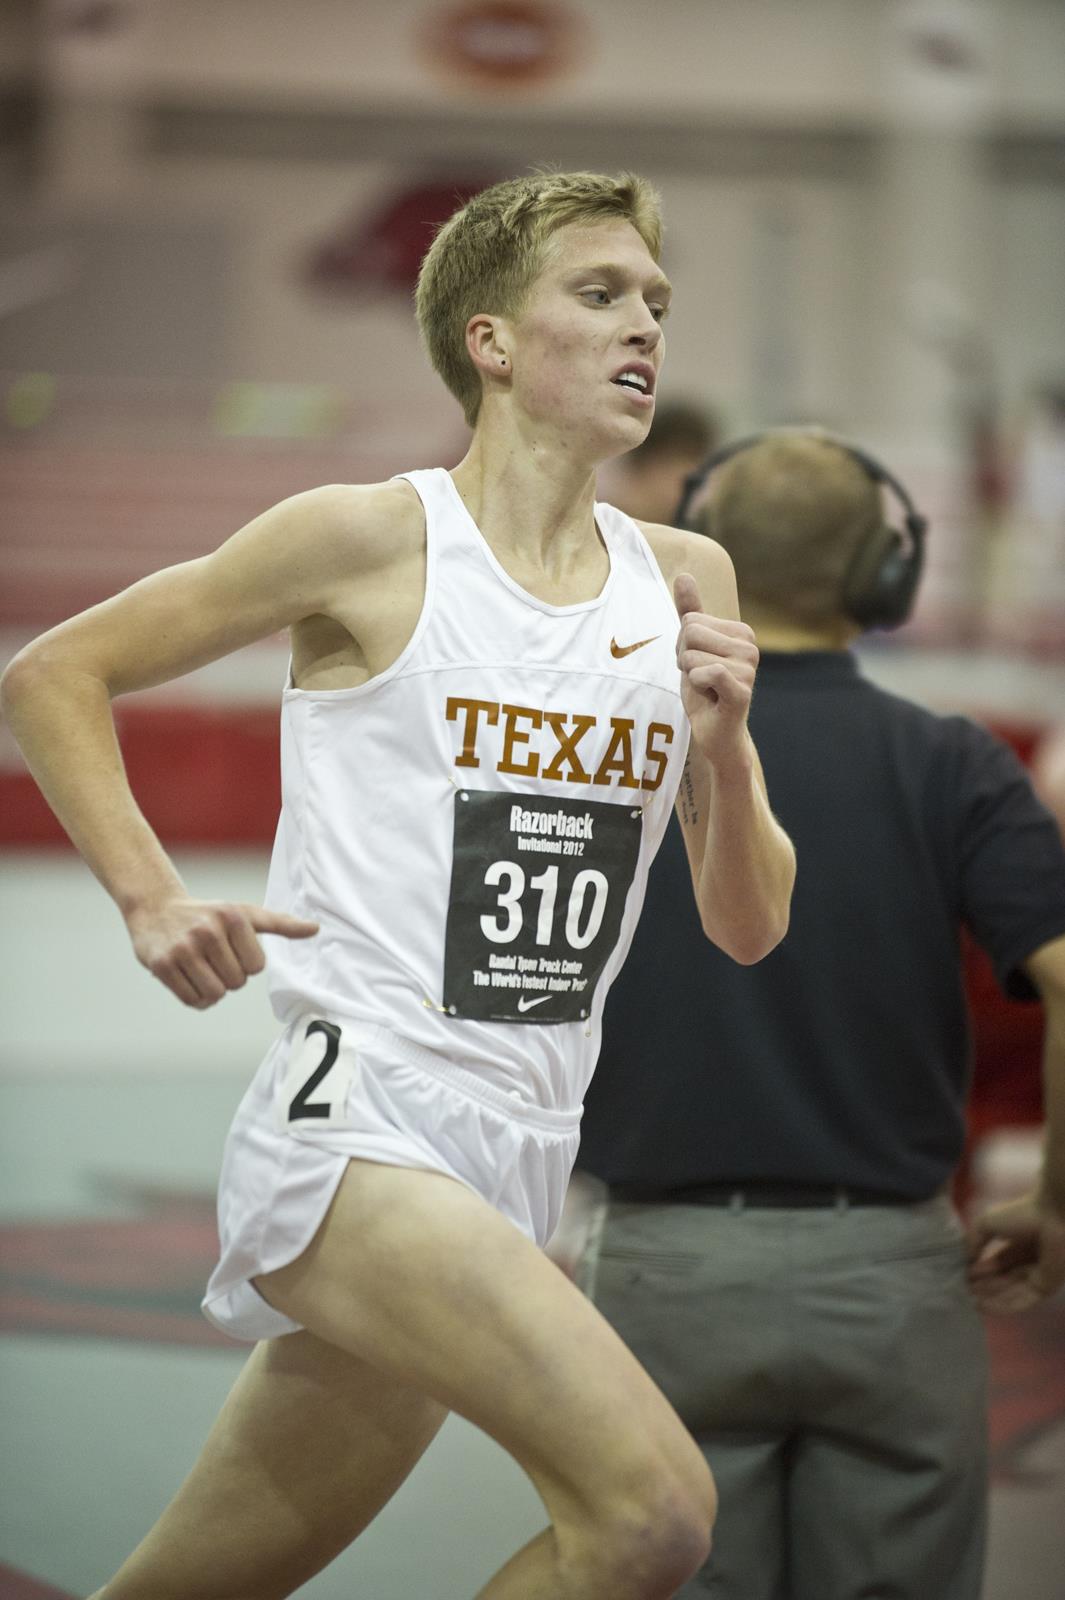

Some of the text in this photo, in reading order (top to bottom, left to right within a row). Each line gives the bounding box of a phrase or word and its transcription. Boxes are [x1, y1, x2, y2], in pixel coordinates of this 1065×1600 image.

[446, 697, 674, 792] TEXAS
[510, 805, 594, 839] Razorback
[517, 836, 585, 857] Invitational 2012
[480, 861, 609, 950] 310
[473, 970, 490, 986] The
[491, 972, 522, 989] World's
[538, 957, 561, 974] Track
[288, 1019, 342, 1122] 2
